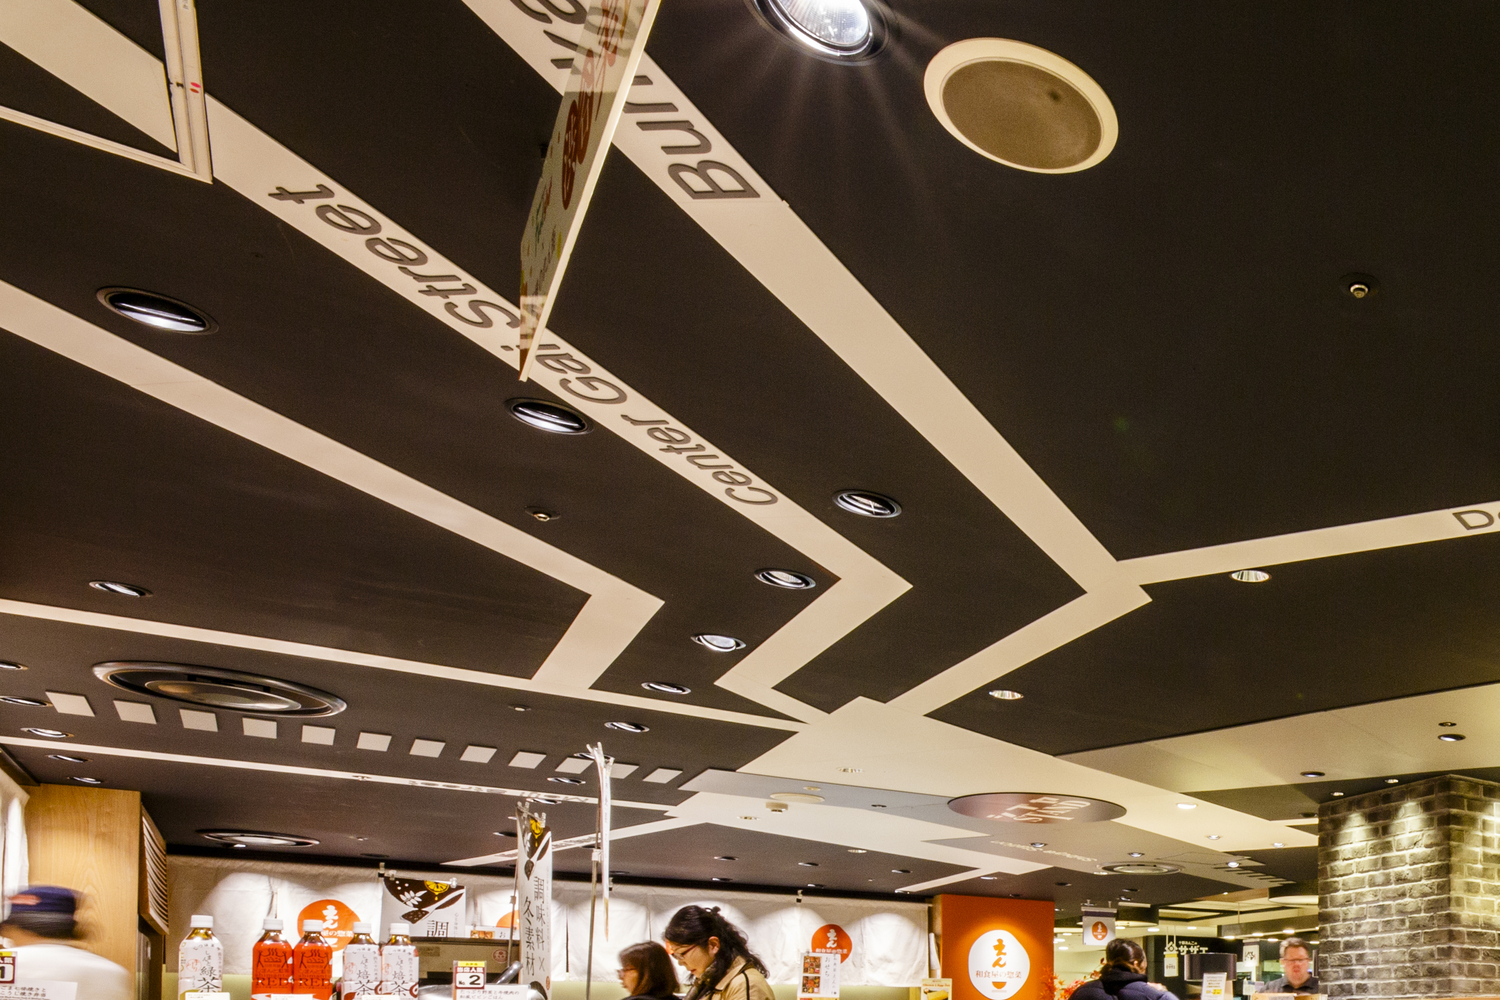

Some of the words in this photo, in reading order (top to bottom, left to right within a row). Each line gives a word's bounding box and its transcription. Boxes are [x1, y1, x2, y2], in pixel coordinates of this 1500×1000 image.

[269, 184, 520, 330] Street
[622, 413, 778, 506] Center
[992, 938, 1007, 968] えん
[975, 970, 1022, 979] 和食屋の惣菜
[256, 977, 289, 986] RED
[299, 978, 331, 987] RED
[469, 975, 481, 985] 2
